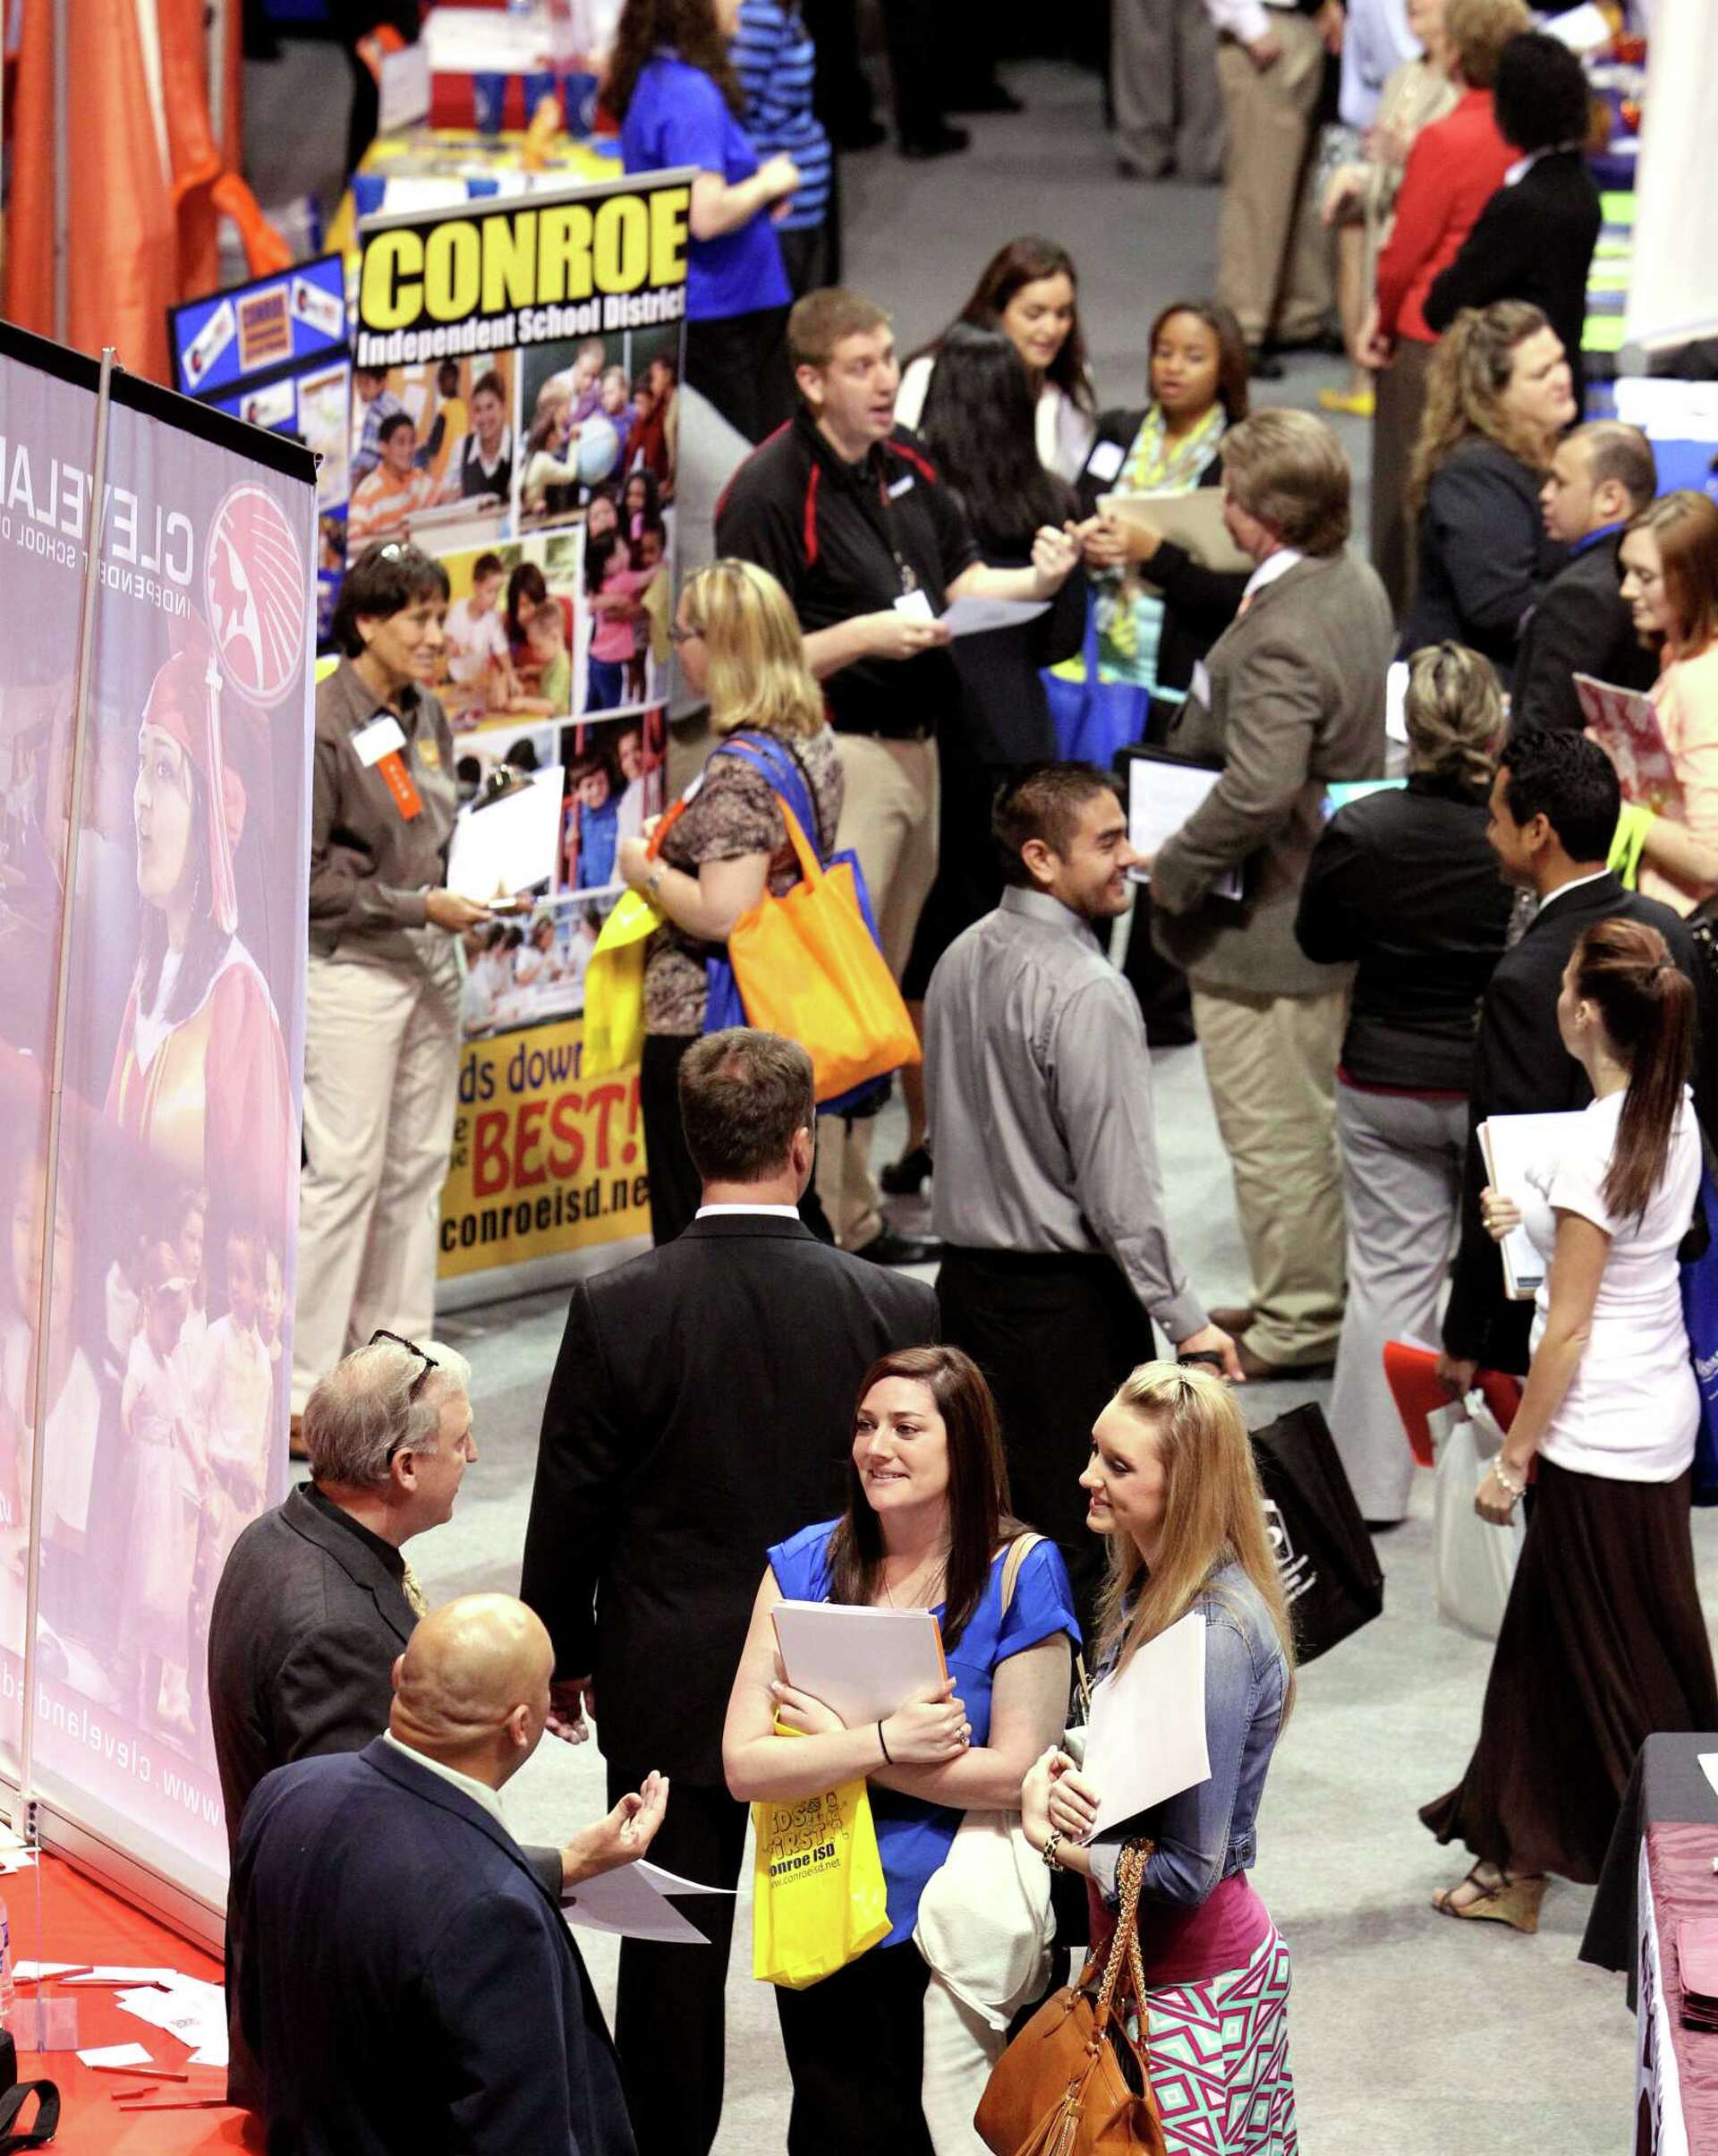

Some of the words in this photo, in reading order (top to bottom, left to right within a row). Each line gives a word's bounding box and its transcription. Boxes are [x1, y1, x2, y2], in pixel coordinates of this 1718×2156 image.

[360, 187, 690, 331] CONROE
[358, 313, 516, 368] Independent
[517, 296, 601, 344] School
[472, 1074, 642, 1200] BEST!
[439, 1174, 651, 1253] conroeisd.ne
[770, 1854, 811, 1878] onroe
[812, 1842, 836, 1862] ISD
[771, 1858, 841, 1888] w.conroeisd.net
